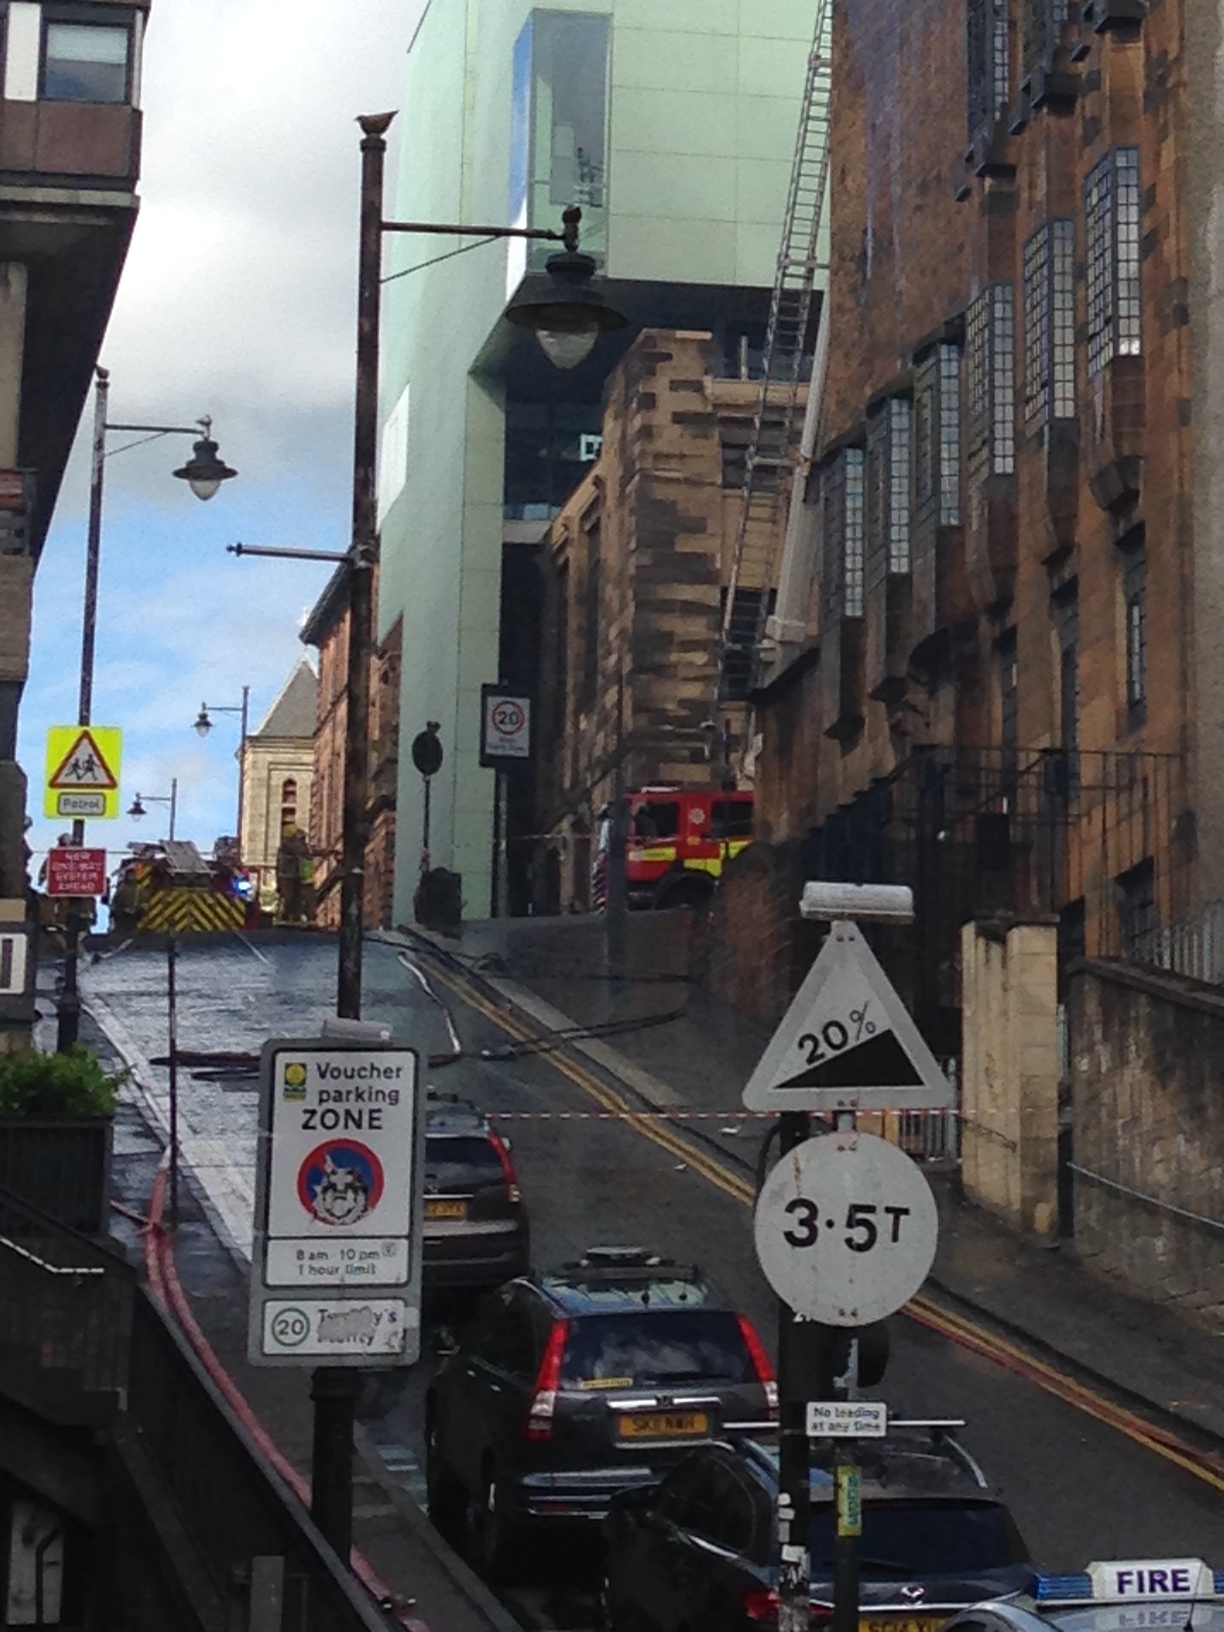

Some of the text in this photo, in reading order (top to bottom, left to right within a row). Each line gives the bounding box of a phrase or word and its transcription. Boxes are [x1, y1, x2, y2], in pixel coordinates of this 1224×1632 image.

[496, 711, 519, 725] 20
[63, 798, 100, 810] Patrol
[797, 1000, 876, 1065] 20%
[316, 1062, 403, 1079] Voucher
[318, 1086, 400, 1105] parking
[301, 1108, 383, 1130] ZONE
[296, 1249, 305, 1261] 8
[308, 1251, 329, 1261] am
[340, 1248, 356, 1260] 10
[359, 1251, 380, 1262] pm
[308, 1264, 340, 1275] hour
[345, 1263, 376, 1275] limit
[276, 1319, 305, 1336] 20
[814, 1407, 880, 1420] No loading
[1116, 1569, 1190, 1595] FIRE
